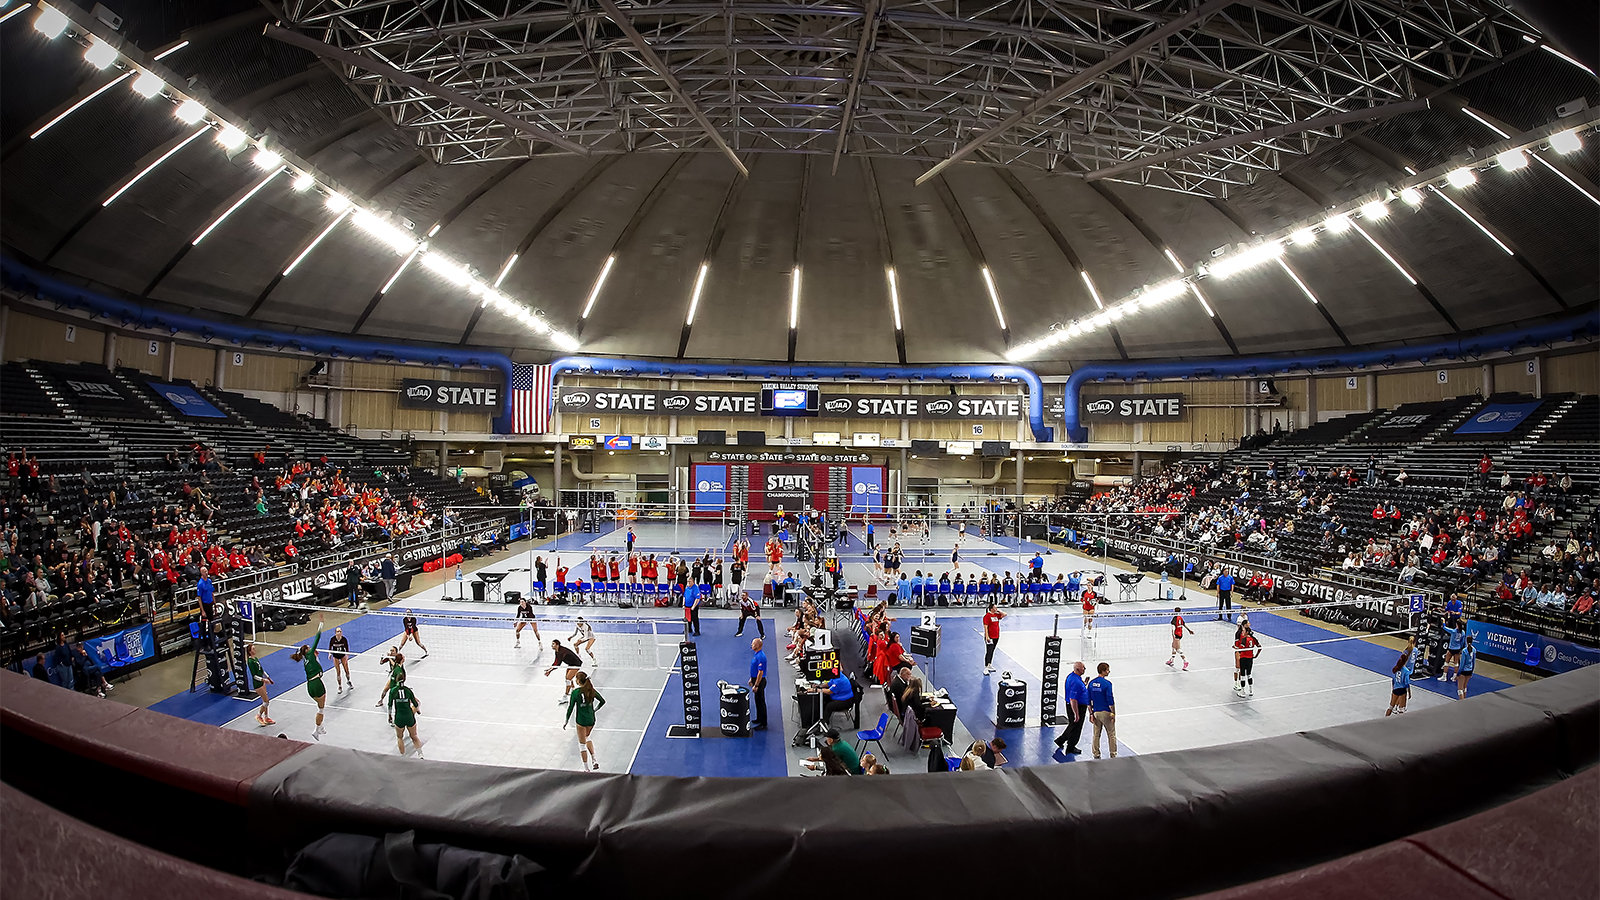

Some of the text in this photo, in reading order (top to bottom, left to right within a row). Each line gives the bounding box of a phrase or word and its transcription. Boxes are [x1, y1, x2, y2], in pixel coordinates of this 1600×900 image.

[67, 327, 74, 340] 7
[150, 342, 157, 353] 5
[234, 353, 242, 365] 3
[1527, 361, 1534, 373] 8
[1439, 371, 1446, 382] 6
[67, 380, 119, 396] STATE
[1262, 383, 1267, 392] 2
[1348, 377, 1356, 388] 4
[437, 386, 496, 406] STATE
[595, 393, 655, 411] STATE
[694, 396, 755, 412] STATE
[857, 399, 917, 415] STATE
[958, 400, 1019, 416] STATE
[1120, 398, 1180, 416] STATE
[591, 420, 600, 428] 15
[1384, 414, 1431, 425] STATE
[973, 426, 983, 434] 16
[722, 453, 858, 462] STATE STATE STATE STATE
[767, 474, 809, 491] STATE
[413, 545, 432, 561] STATE
[1113, 540, 1130, 552] STATE
[1137, 546, 1157, 557] STATE
[281, 577, 312, 600] STATE
[1300, 581, 1335, 600] STATE
[1355, 594, 1394, 616] STATE
[1413, 599, 1420, 609] 2
[243, 604, 248, 615] 1
[923, 615, 931, 626] 2
[819, 634, 826, 646] 1
[1486, 631, 1517, 646] VICTORY
[830, 652, 836, 661] 0
[834, 659, 839, 669] 2
[816, 669, 821, 678] 8
[398, 689, 406, 699] 11
[581, 693, 585, 703] 1
